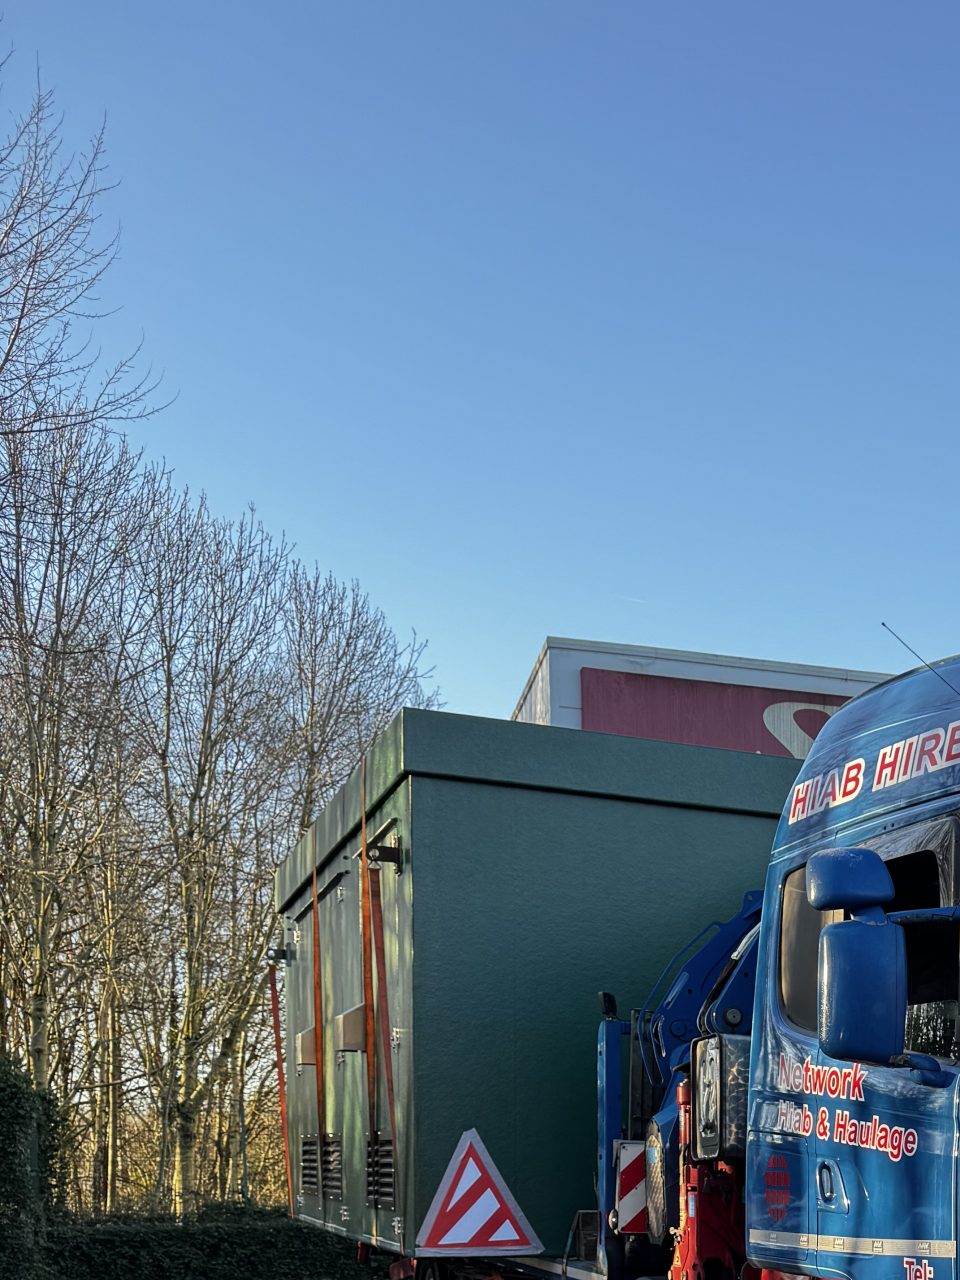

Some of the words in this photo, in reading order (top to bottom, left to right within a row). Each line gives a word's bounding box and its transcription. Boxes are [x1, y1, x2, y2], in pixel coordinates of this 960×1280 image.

[788, 757, 866, 825] HIAB
[778, 1053, 868, 1101] Network
[775, 1099, 813, 1136] Hiab
[816, 1107, 830, 1141] &
[833, 1109, 918, 1161] Haulage
